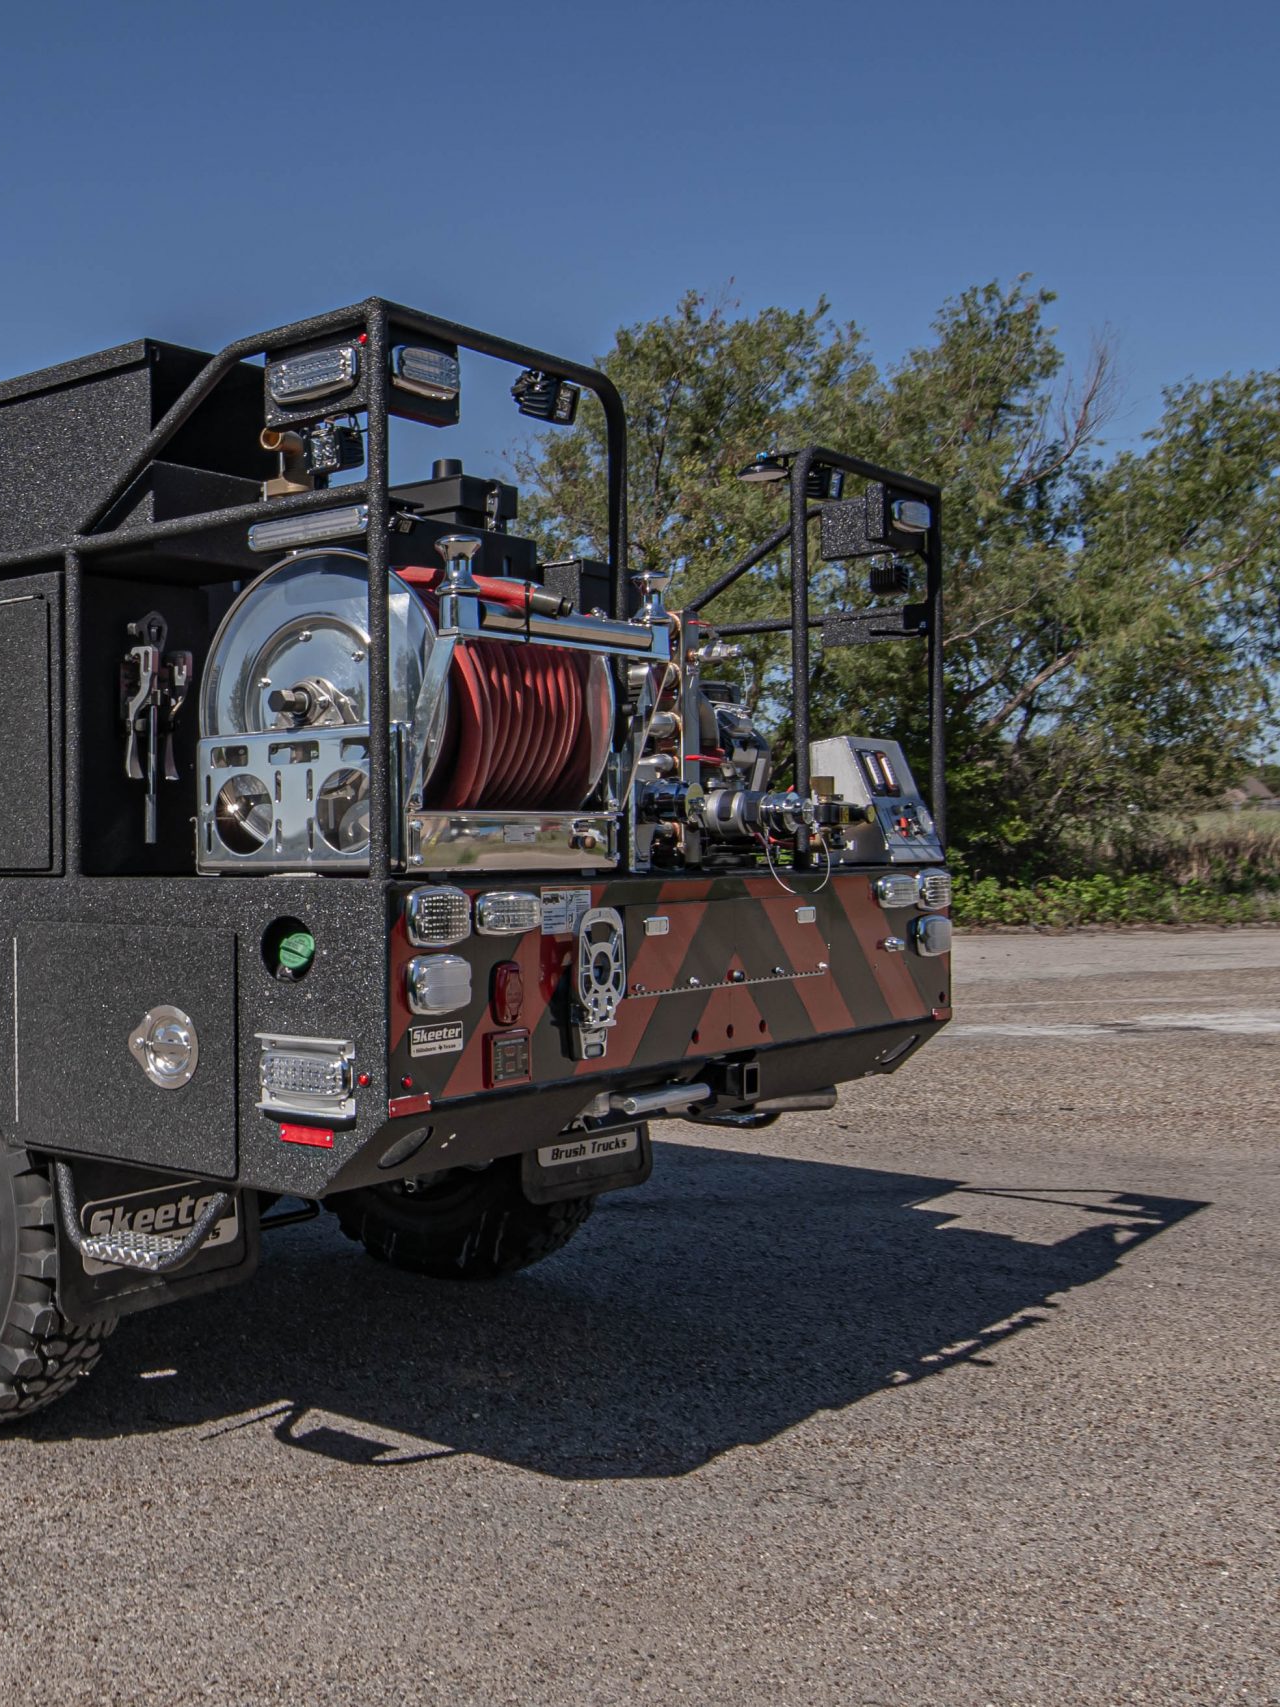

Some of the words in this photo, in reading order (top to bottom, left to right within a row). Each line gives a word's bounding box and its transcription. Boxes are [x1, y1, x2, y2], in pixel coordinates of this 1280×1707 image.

[412, 1027, 461, 1044] Skeeter
[551, 1143, 586, 1161] Brush
[591, 1137, 628, 1154] Trucks
